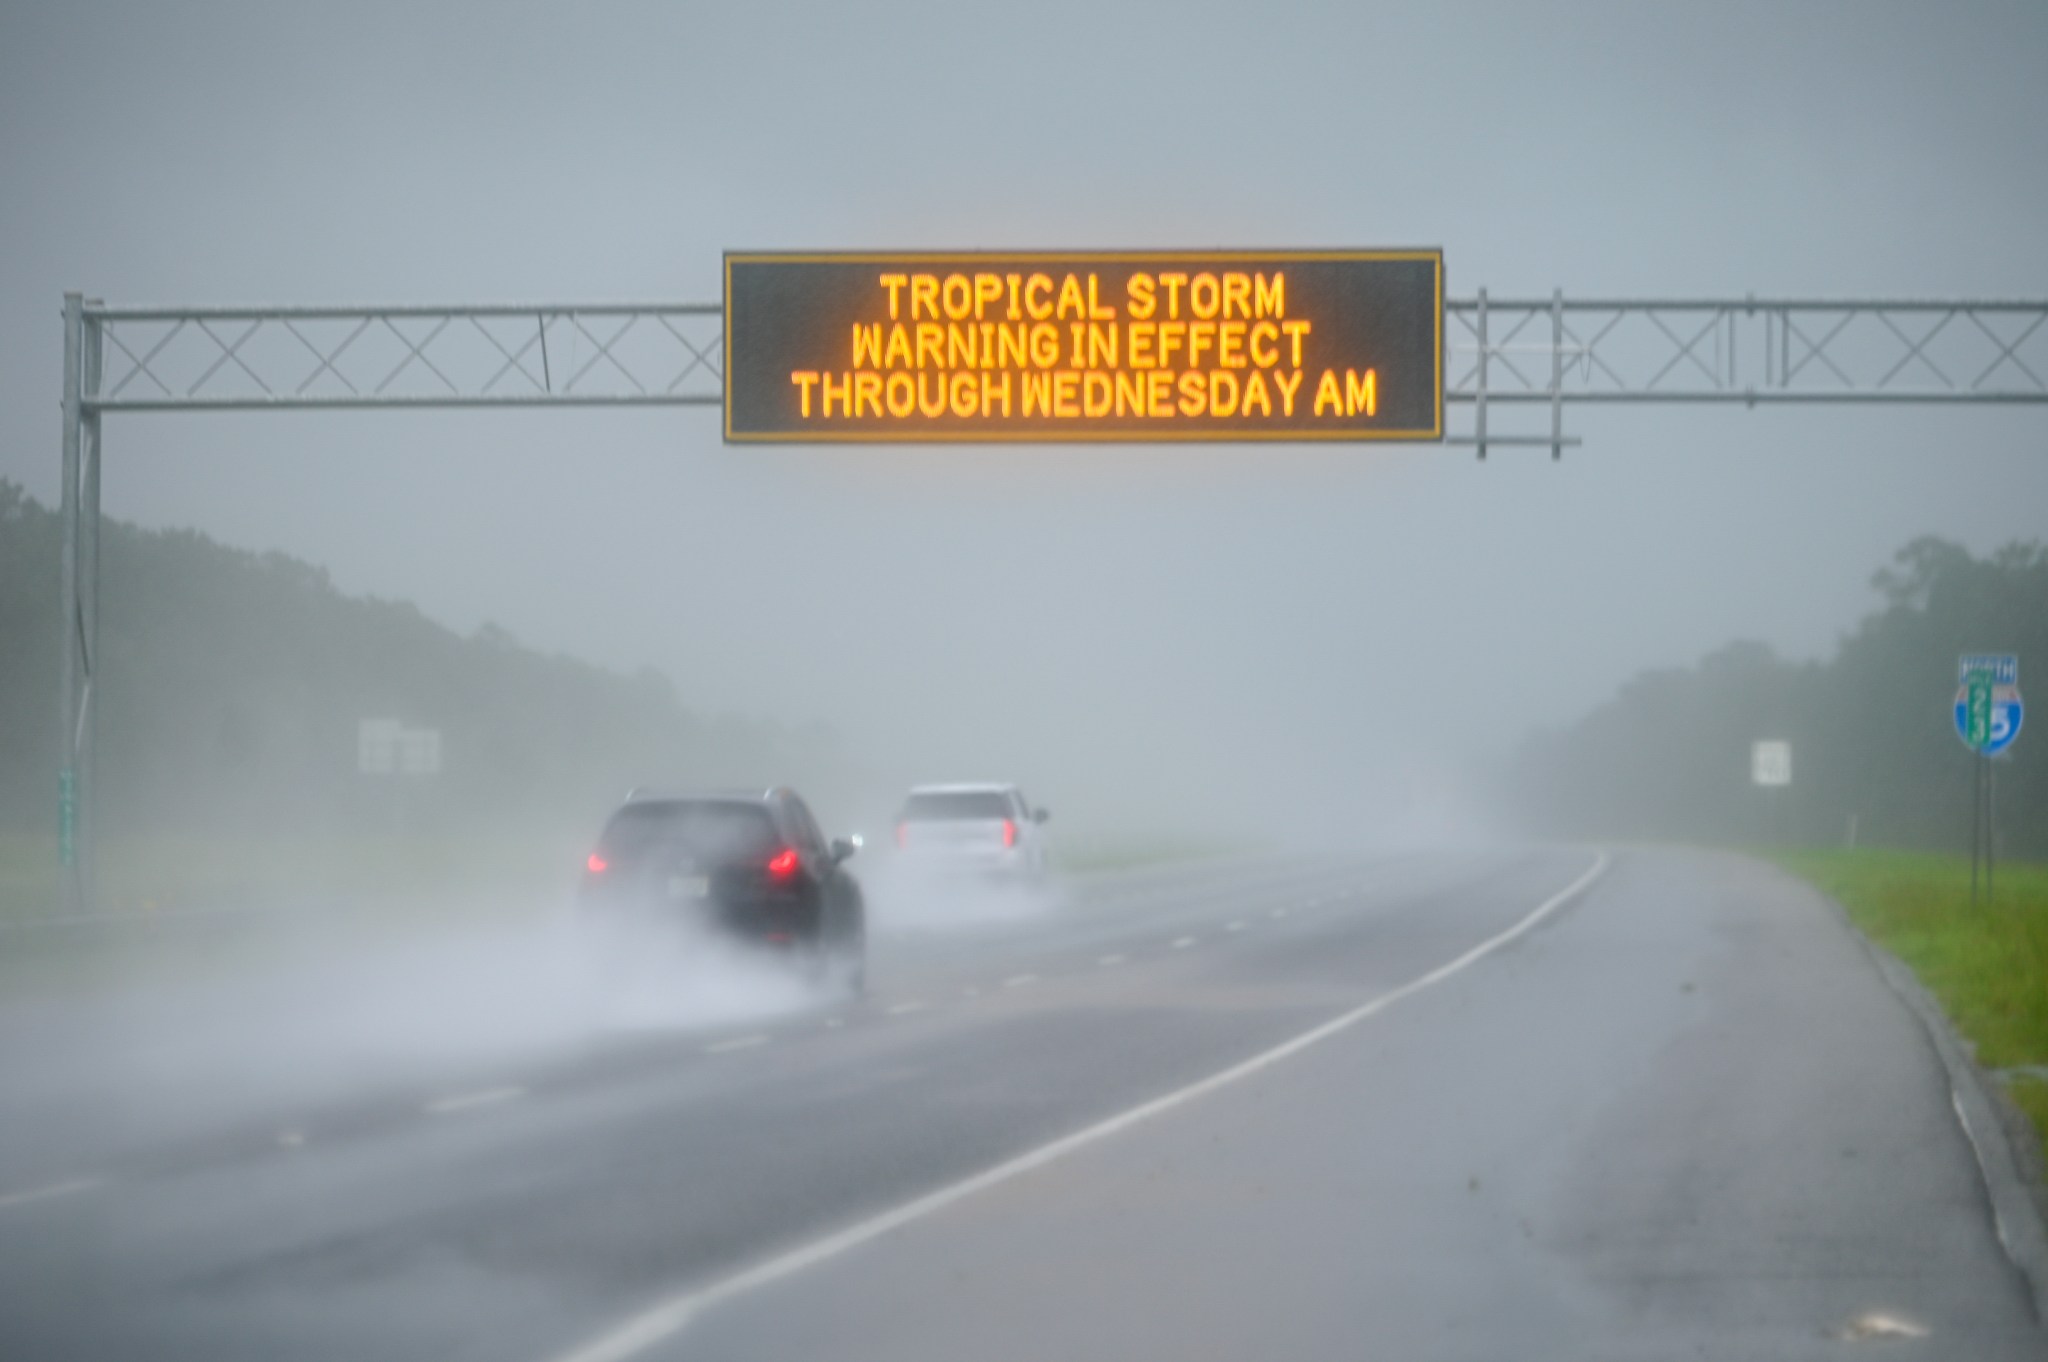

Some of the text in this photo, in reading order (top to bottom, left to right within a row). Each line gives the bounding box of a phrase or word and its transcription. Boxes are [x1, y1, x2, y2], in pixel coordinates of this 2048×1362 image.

[880, 273, 1285, 320] TROPICAL STORM
[853, 321, 1311, 369] WARNING IN EFFECT
[791, 369, 1377, 418] THROUGH WEDNESDAY AM
